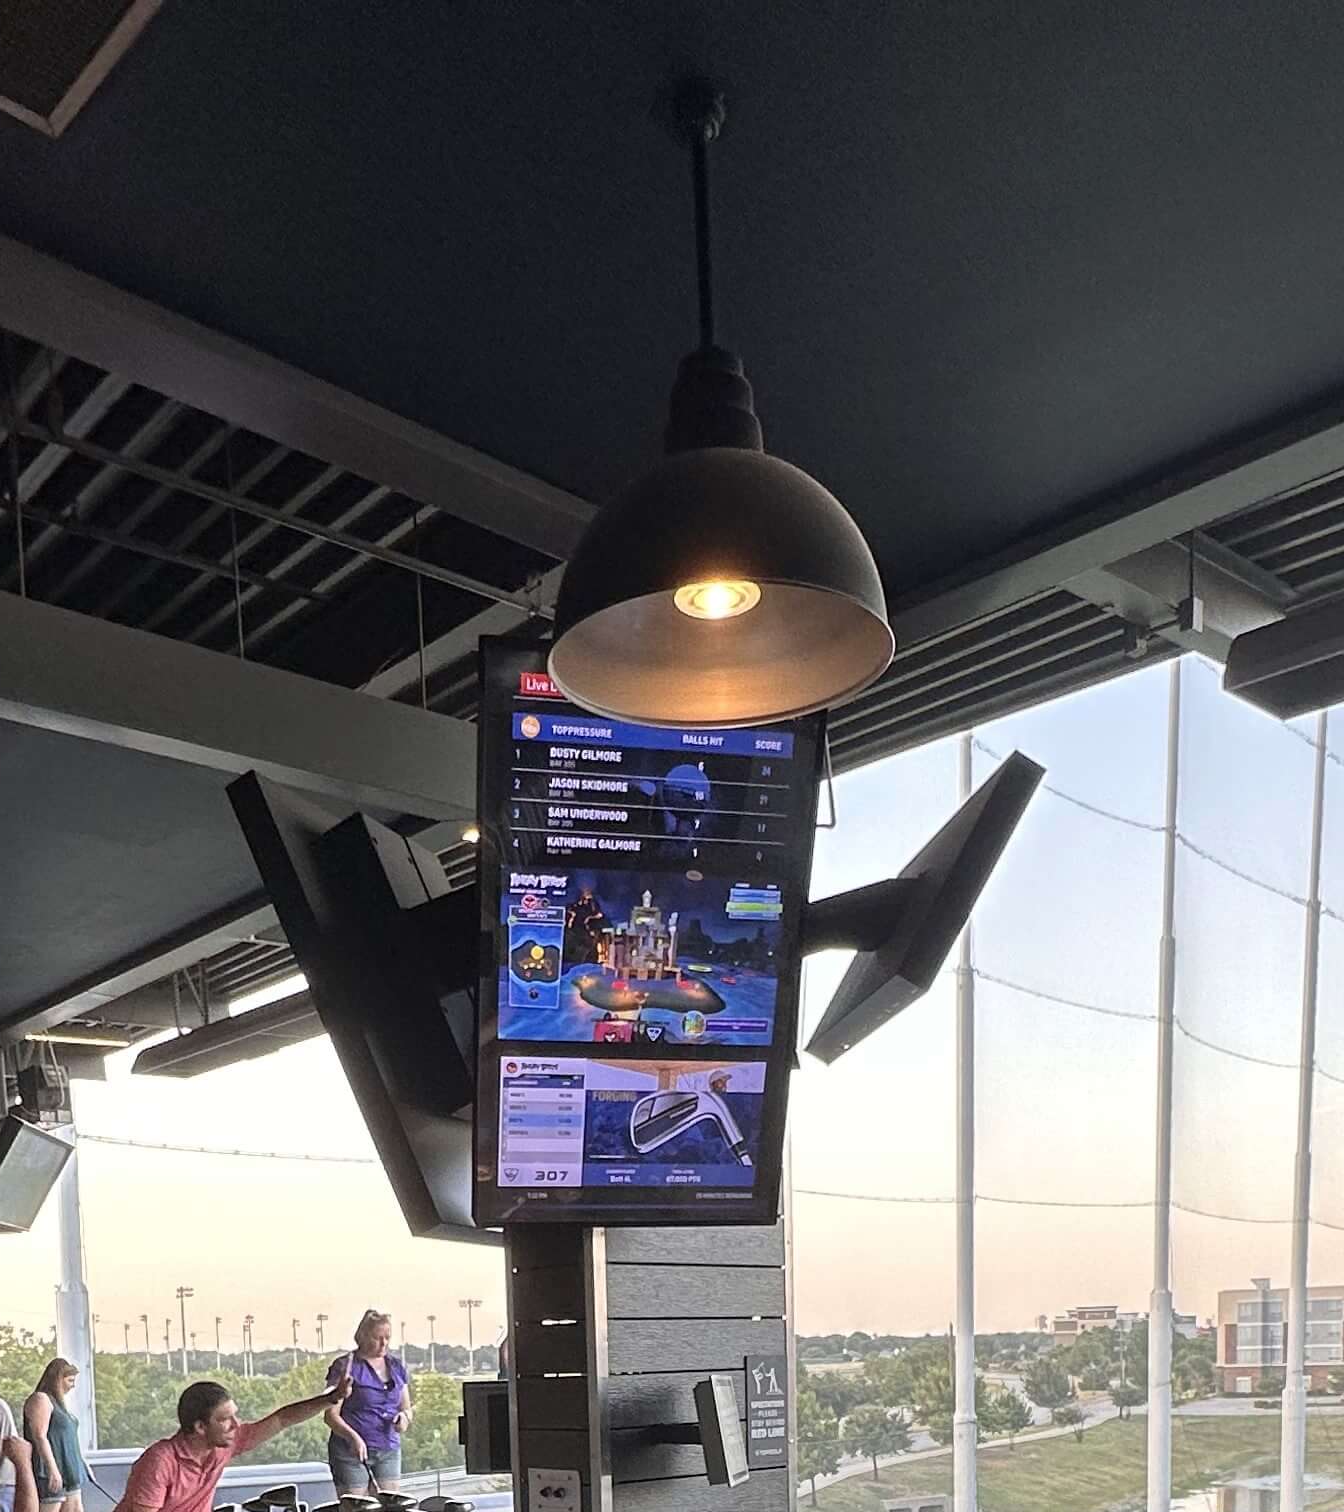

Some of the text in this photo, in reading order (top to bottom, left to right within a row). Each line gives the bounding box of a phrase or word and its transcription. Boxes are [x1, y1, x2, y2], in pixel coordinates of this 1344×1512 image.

[526, 677, 549, 692] Live
[551, 725, 613, 739] TOPPRESSURE
[682, 734, 724, 747] BALLS HIT
[755, 739, 783, 751] SCORE
[549, 747, 623, 763] DUSTY GILMORE
[548, 777, 629, 793] JASON SKIDMORE
[547, 806, 628, 822] SAM UNDERWOOD
[546, 836, 597, 849] KATHERINE
[534, 1170, 569, 1181] 307
